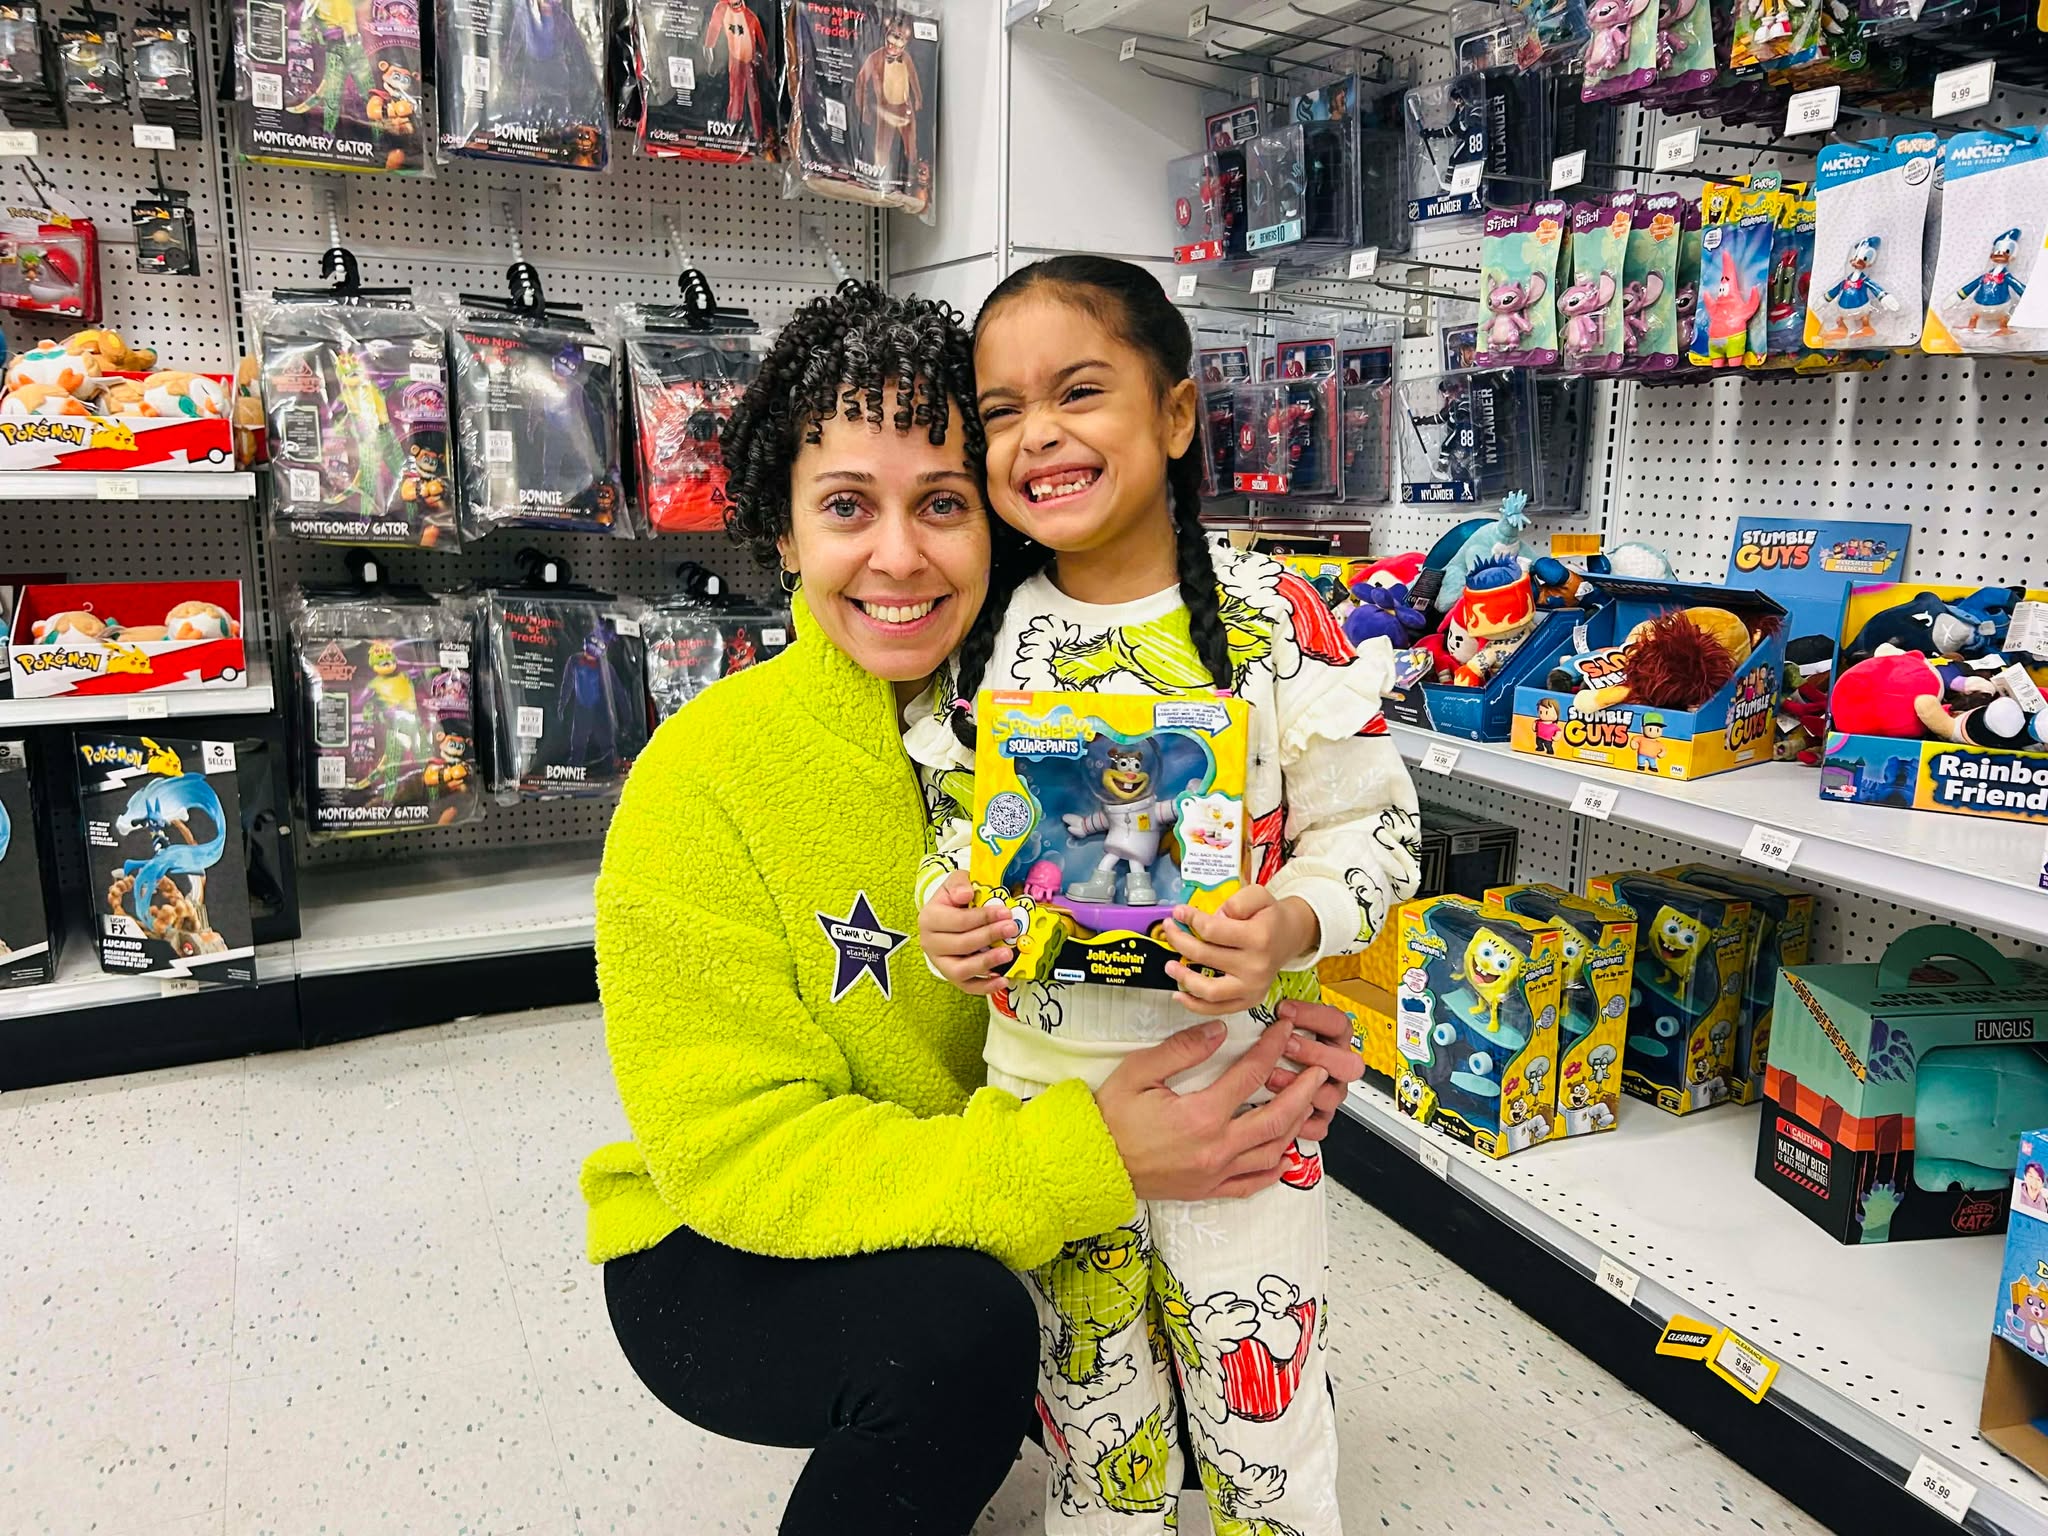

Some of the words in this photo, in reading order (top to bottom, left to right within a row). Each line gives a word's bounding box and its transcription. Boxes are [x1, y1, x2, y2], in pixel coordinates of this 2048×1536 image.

[808, 3, 828, 14] Five
[1951, 87, 1970, 102] 9.99
[1803, 108, 1820, 120] 9.99
[494, 122, 538, 146] BONNIE
[707, 120, 736, 137] FOXY
[1492, 94, 1506, 176] NYLANDER
[253, 129, 333, 151] MONTGOMERY
[336, 141, 374, 158] GATOR
[1468, 133, 1483, 154] 88
[1951, 143, 2016, 161] MICKEY
[1668, 147, 1682, 159] 9.99
[1956, 159, 1972, 167] AND
[1974, 157, 2006, 166] FRIENDS
[854, 159, 886, 176] FREDDY
[1821, 154, 1871, 172] MICKEY
[1561, 168, 1573, 179] 9.99
[1840, 168, 1864, 177] FRIENDS
[1179, 204, 1187, 219] 14
[1426, 199, 1462, 217] NYLANDER
[1277, 225, 1285, 242] 10
[1481, 387, 1497, 464] NYLANDER
[1243, 431, 1252, 444] 14
[1460, 429, 1474, 447] 88
[520, 488, 563, 505] BONNIE
[1420, 488, 1454, 501] NYLANDER
[291, 520, 371, 536] MONTGOMERY
[372, 521, 410, 536] GATOR
[1741, 528, 1818, 546] STUMBLE
[1735, 544, 1811, 572] GUYS
[14, 647, 102, 675] Pokémon
[1735, 695, 1771, 719] STUMBLE
[1568, 706, 1633, 727] STUMBLE
[1563, 721, 1630, 748] GUYS
[1729, 708, 1768, 752] GUYS
[1008, 739, 1079, 754] SQUAREPANTS
[208, 757, 233, 767] SELECT
[1432, 755, 1448, 766] 14.99
[546, 764, 587, 780] BONNIE
[1938, 754, 2048, 787] Rainbo
[1944, 779, 2048, 811] Friend
[318, 805, 392, 821] MONTGOMERY
[394, 805, 429, 819] GATOR
[1760, 842, 1783, 859] 19.99
[111, 923, 127, 936] FX
[103, 938, 142, 951] LUCARIO
[1794, 980, 1811, 1004] DANGER
[1809, 1002, 1827, 1026] DANGER
[1826, 1024, 1841, 1046] SERIES
[1977, 1020, 2032, 1040] FUNGUS
[1792, 1128, 1823, 1151] CAUTION
[1778, 1138, 1795, 1158] KATZ
[1795, 1147, 1810, 1167] MAY
[1810, 1156, 1829, 1178] BITE!
[1783, 1154, 1795, 1169] KATZ
[1794, 1161, 1806, 1175] PEUT
[1957, 1214, 1994, 1230] KATZ
[1667, 1332, 1708, 1345] CLEARANCE
[1734, 1338, 1763, 1362] CLEARANCE
[1734, 1357, 1752, 1375] 9.98
[1923, 1476, 1951, 1499] 35.99
